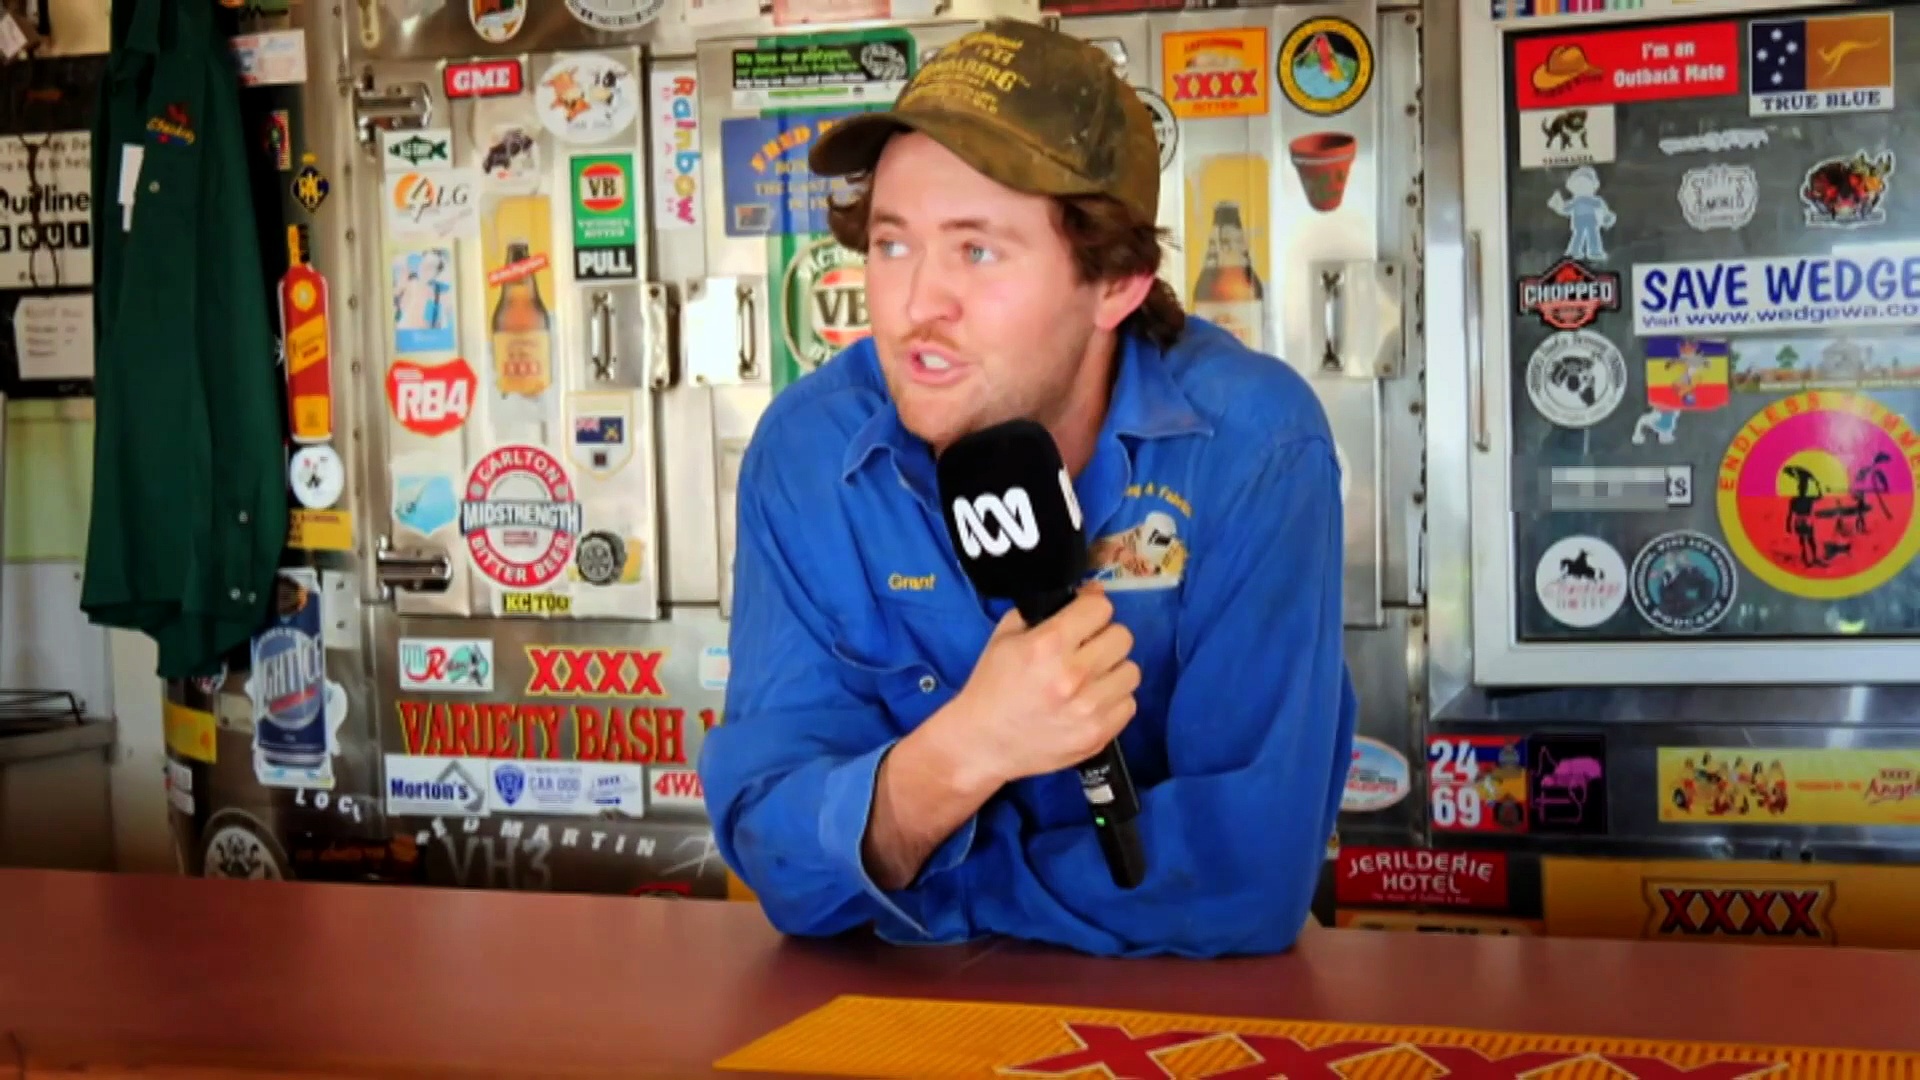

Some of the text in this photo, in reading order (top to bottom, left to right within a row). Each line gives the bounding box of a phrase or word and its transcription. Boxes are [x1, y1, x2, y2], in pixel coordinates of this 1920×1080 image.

[1642, 42, 1695, 59] I'm an
[452, 66, 511, 91] GME
[1173, 69, 1258, 100] XXXX
[1613, 62, 1725, 87] Outback Mate
[1761, 90, 1882, 112] TRUE BLUE
[672, 76, 702, 225] Rainbow
[588, 177, 618, 197] VB
[579, 249, 632, 275] PULL
[1524, 281, 1614, 303] CHOPPED
[1641, 256, 1920, 313] SAVE WEDGE
[478, 451, 561, 483] CARLTON
[463, 502, 580, 533] MIDSTRENGTH
[471, 536, 528, 582] BITTER
[888, 571, 936, 591] Grant
[526, 648, 668, 696] XXXX
[397, 702, 563, 759] VARIETY
[573, 704, 688, 763] BASH
[1430, 740, 1479, 783] 24
[391, 779, 468, 801] Morton's
[1430, 786, 1481, 826] 69
[501, 818, 656, 857] MARTIN
[1347, 850, 1494, 882] JERILDERIE
[1382, 873, 1461, 894] HOTEL
[1658, 888, 1823, 936] XXXX
